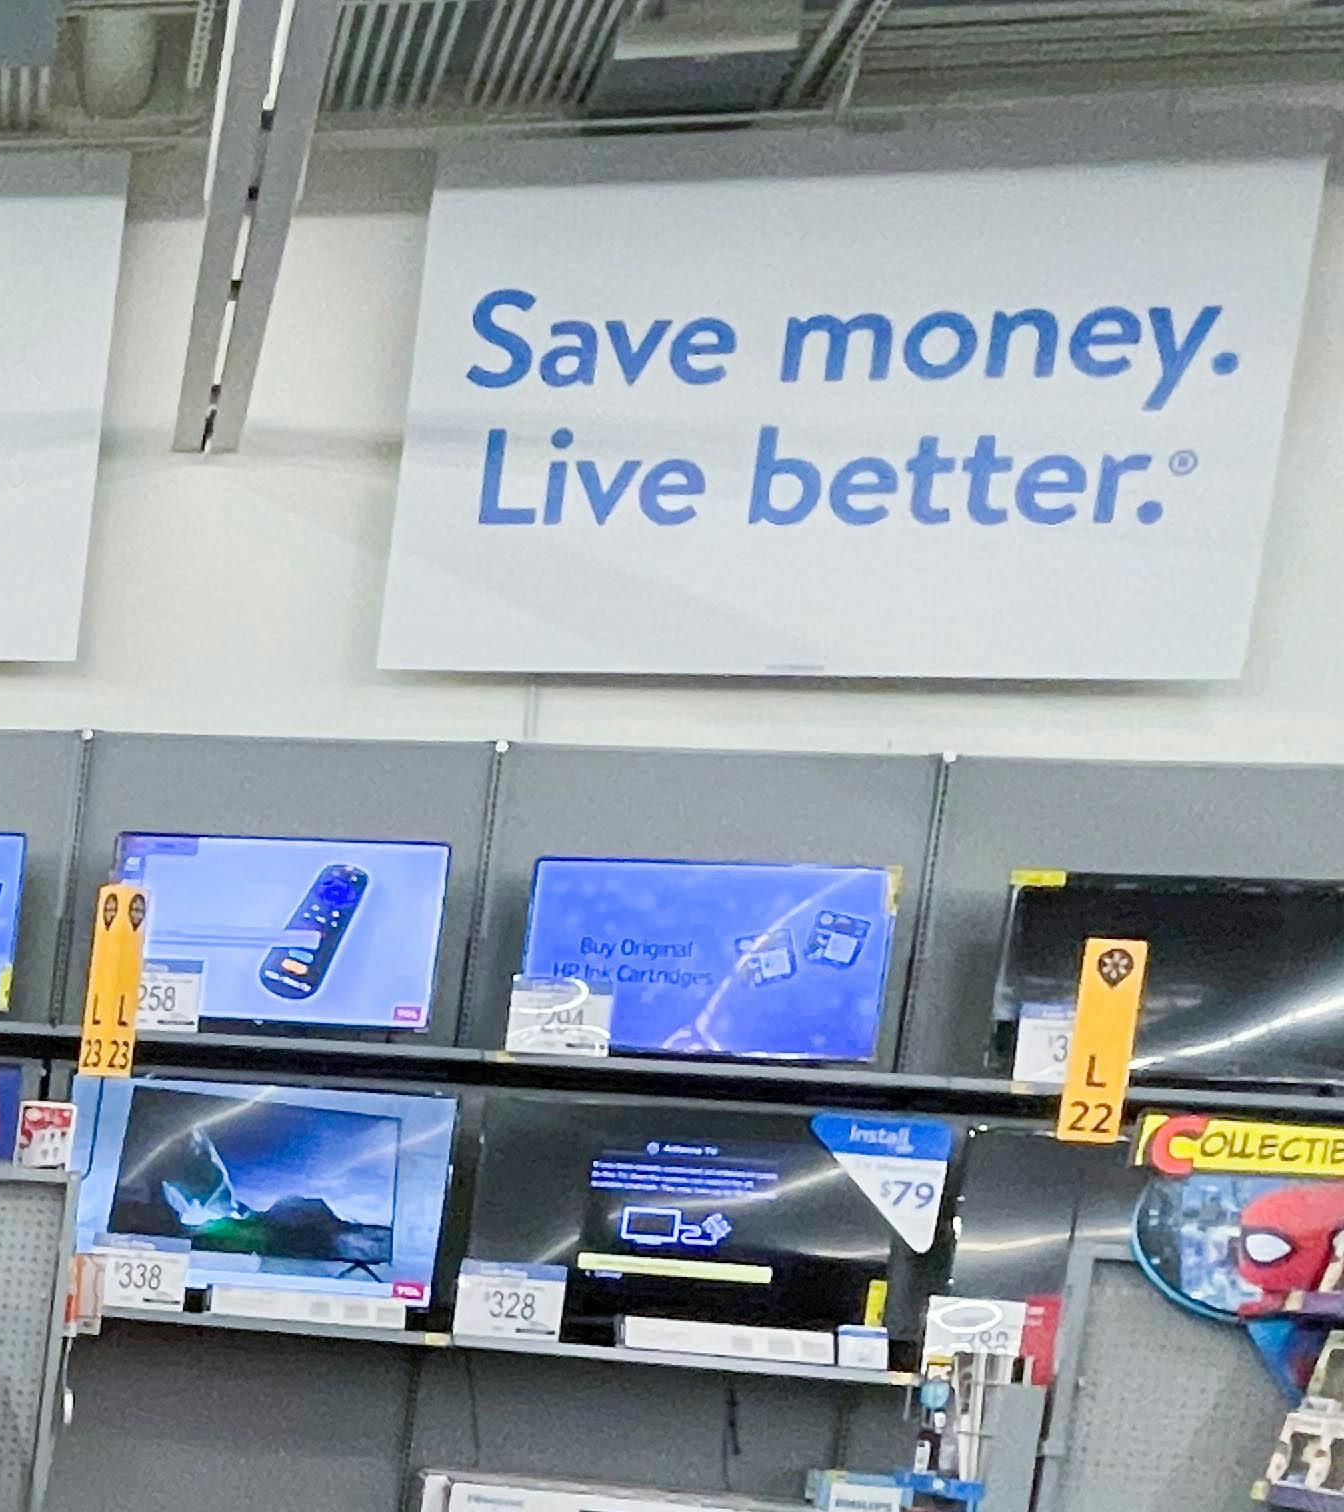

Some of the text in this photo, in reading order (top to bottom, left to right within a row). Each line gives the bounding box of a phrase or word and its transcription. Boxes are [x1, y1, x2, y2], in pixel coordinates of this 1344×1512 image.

[465, 287, 1241, 411] Save money.
[477, 427, 707, 527] Live
[581, 936, 694, 961] Buy Original
[82, 1039, 103, 1068] 23
[107, 1040, 131, 1070] 23
[1085, 1053, 1107, 1088] L
[1068, 1100, 1113, 1134] 22
